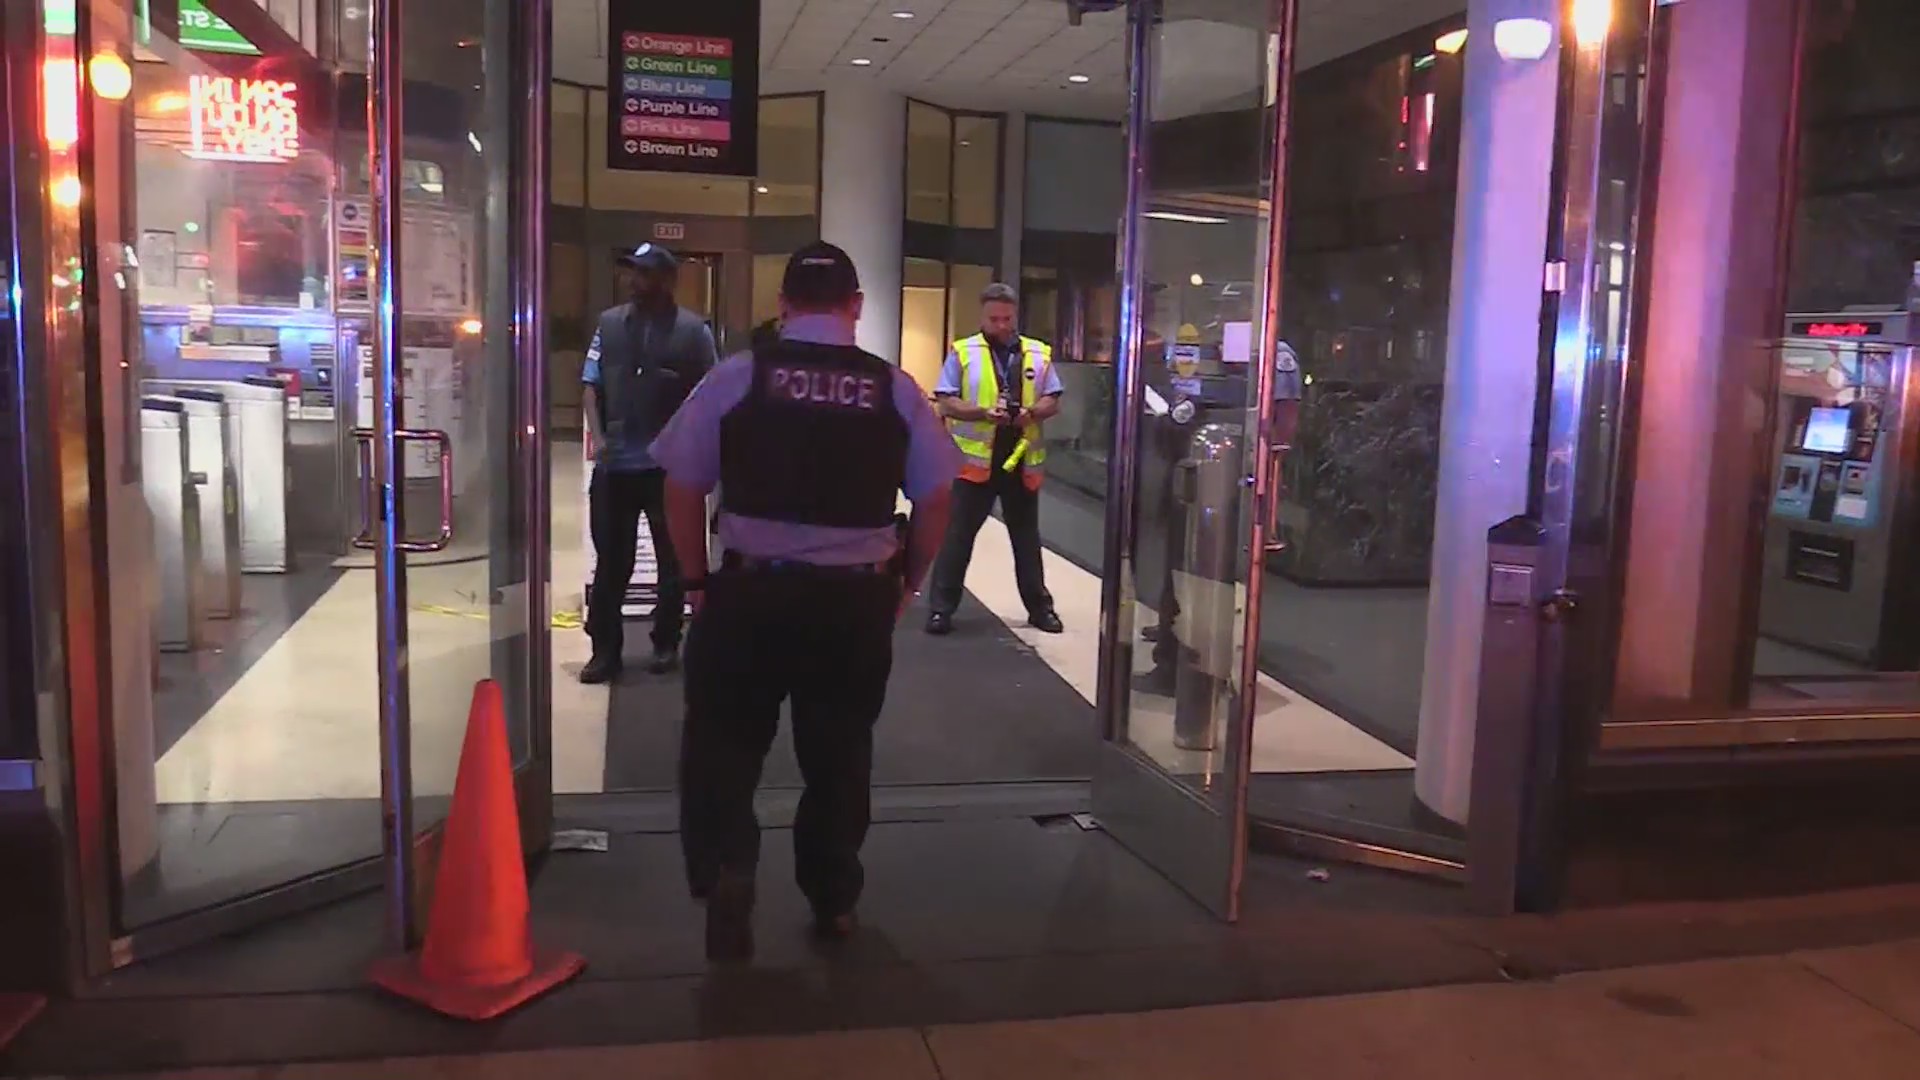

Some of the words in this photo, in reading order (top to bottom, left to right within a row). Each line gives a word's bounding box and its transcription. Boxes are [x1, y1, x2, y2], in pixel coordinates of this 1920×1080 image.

[641, 37, 693, 55] Orange
[697, 41, 726, 54] Line
[641, 58, 683, 72] Green
[687, 60, 717, 75] Line
[641, 78, 673, 92] Blue
[676, 81, 706, 95] Line
[640, 99, 685, 116] Purple
[689, 103, 719, 117] Line
[640, 120, 669, 133] Pink
[673, 123, 701, 135] Line
[640, 141, 685, 156] Brown
[688, 144, 718, 158] Line
[774, 368, 874, 408] POLICE
